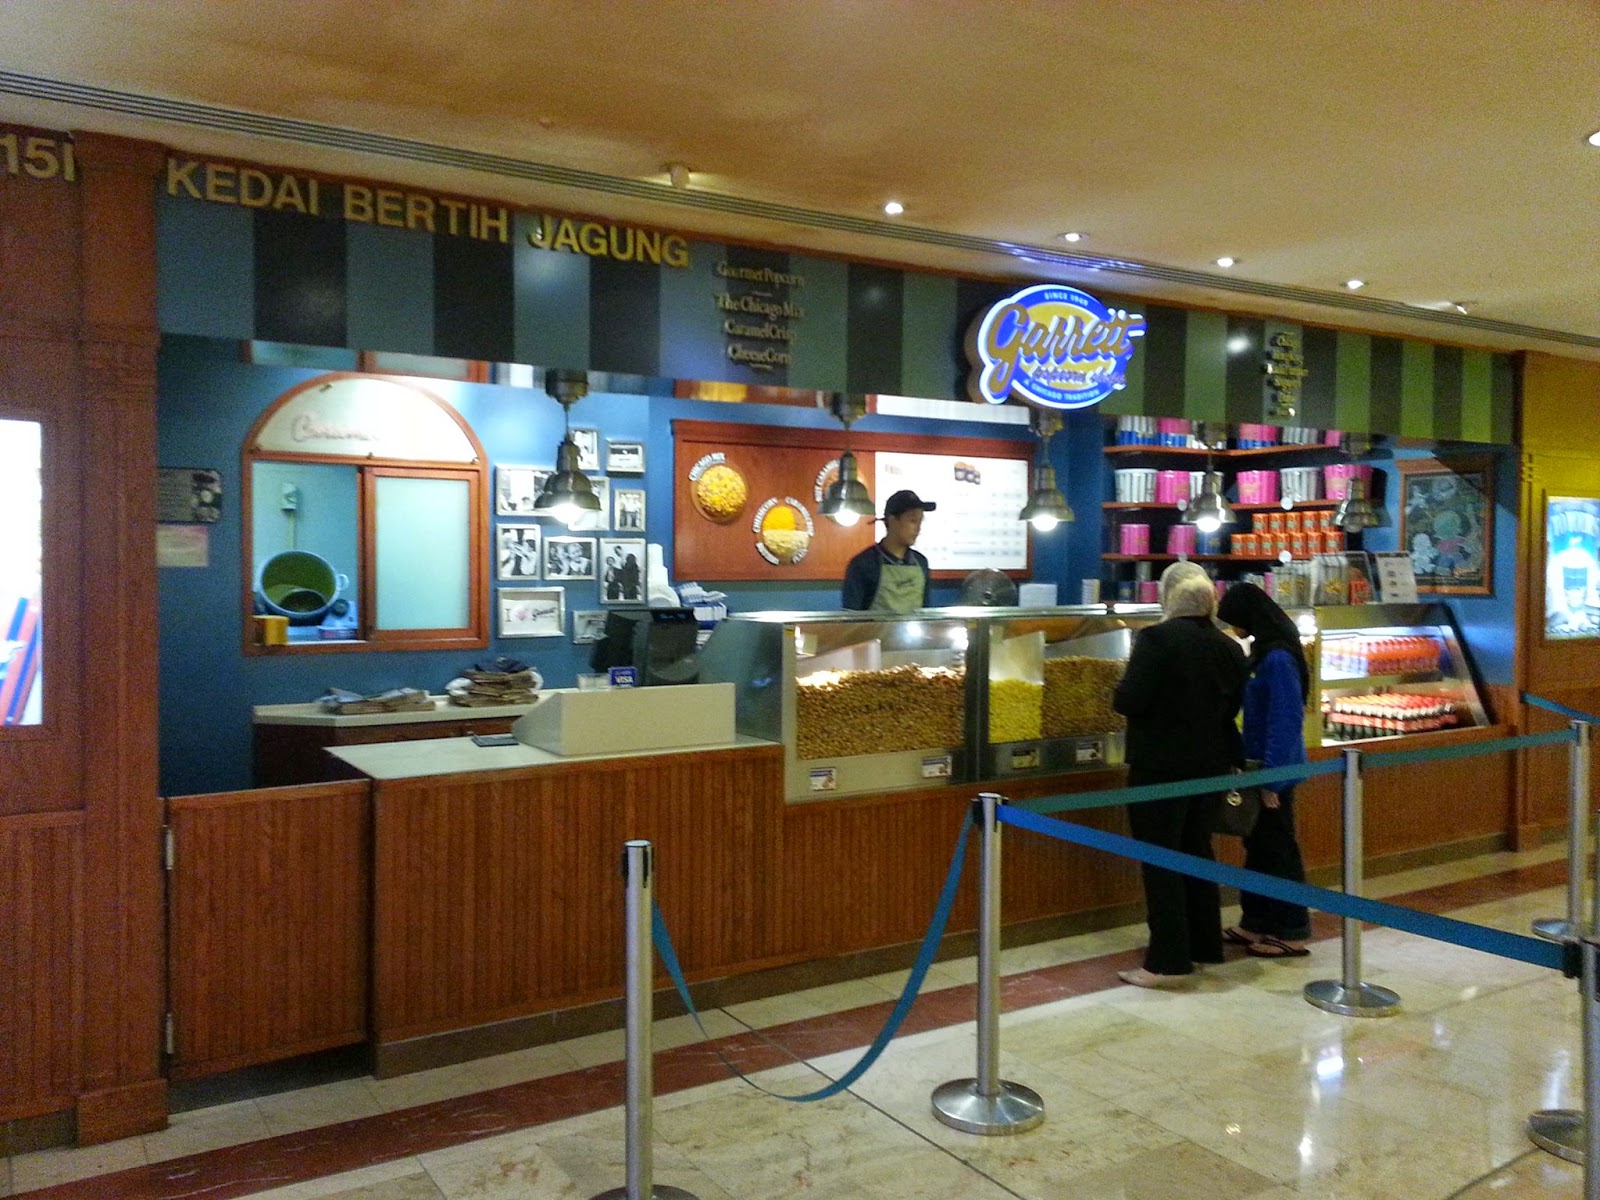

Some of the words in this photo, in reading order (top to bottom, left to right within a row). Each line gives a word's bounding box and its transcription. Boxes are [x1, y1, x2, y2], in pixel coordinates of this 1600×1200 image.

[165, 156, 319, 216] KEDAI
[343, 184, 510, 244] BERTIH
[528, 214, 691, 269] JAGUNG
[740, 295, 783, 321] Chicago
[986, 302, 1146, 394] Garrett
